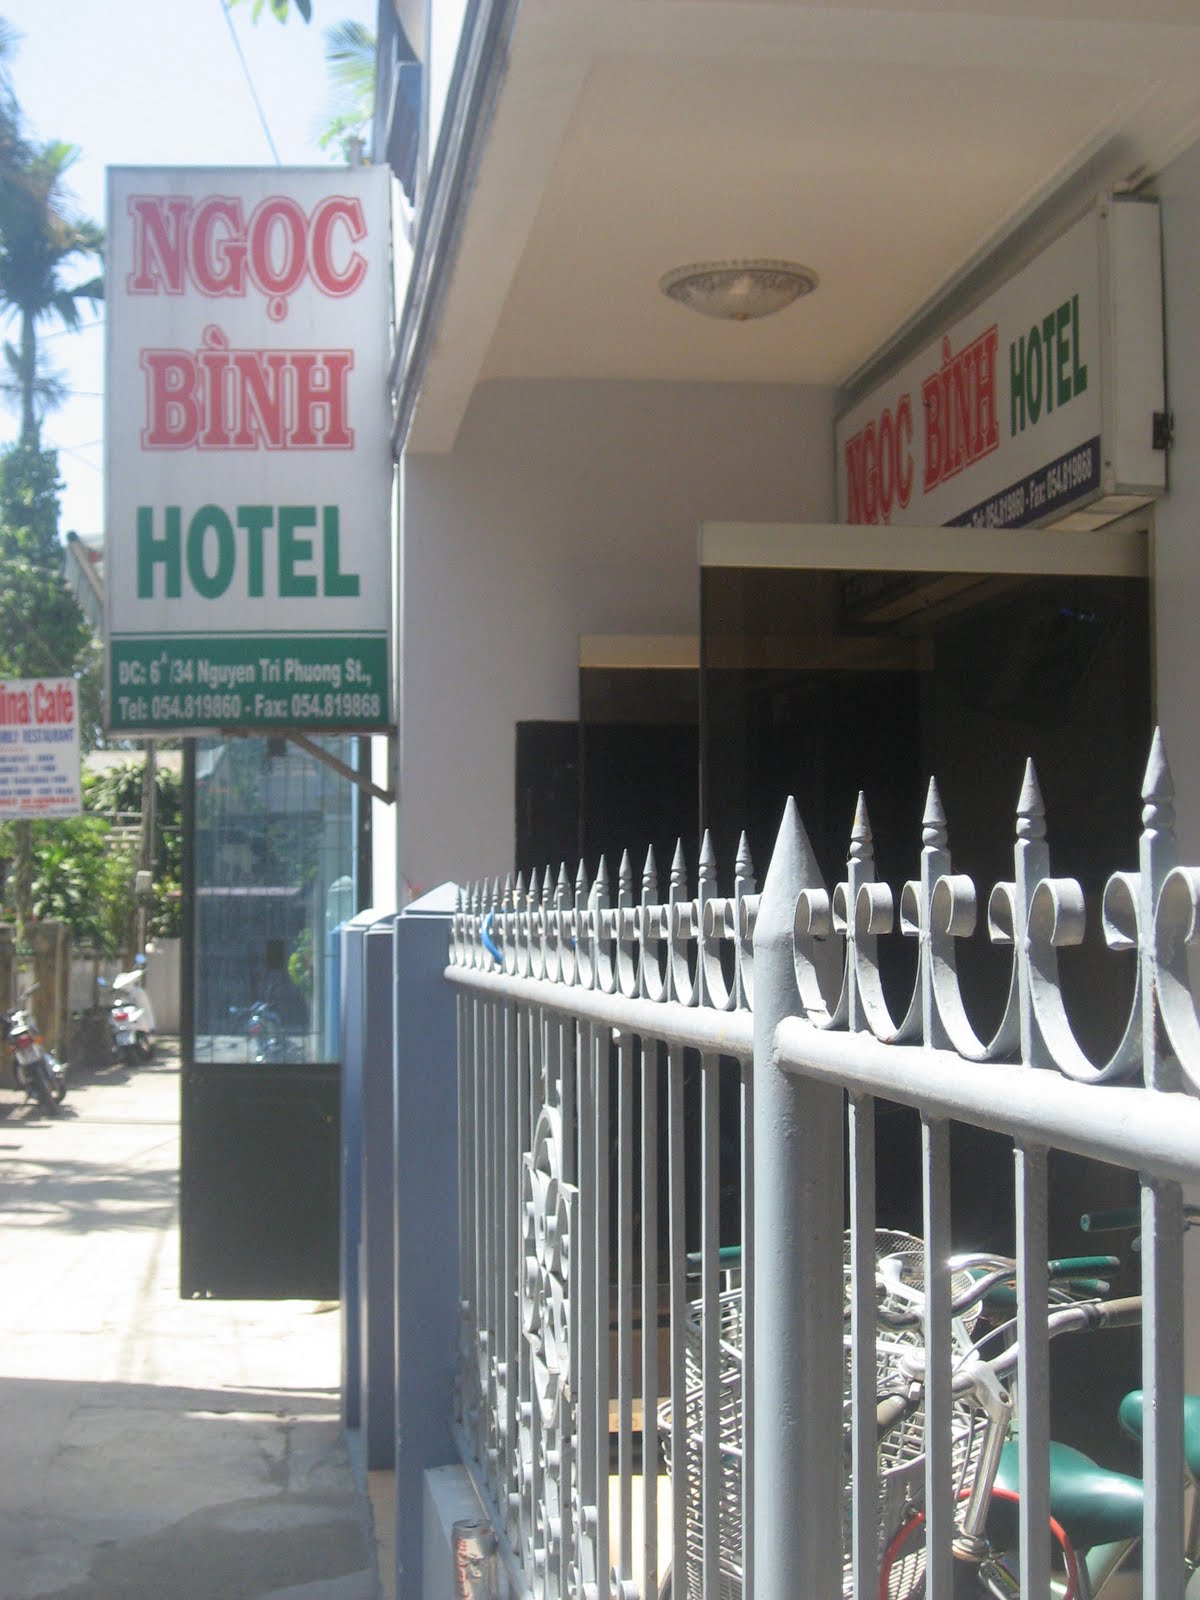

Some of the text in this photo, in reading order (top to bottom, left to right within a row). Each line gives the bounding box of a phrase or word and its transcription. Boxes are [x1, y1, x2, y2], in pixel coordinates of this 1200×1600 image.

[139, 323, 355, 451] BÌNH
[1010, 294, 1088, 437] HOTEL
[136, 503, 361, 599] HOTEL
[197, 658, 256, 690] Nguyen
[283, 657, 343, 689] Phuong
[254, 693, 289, 718] Fax:
